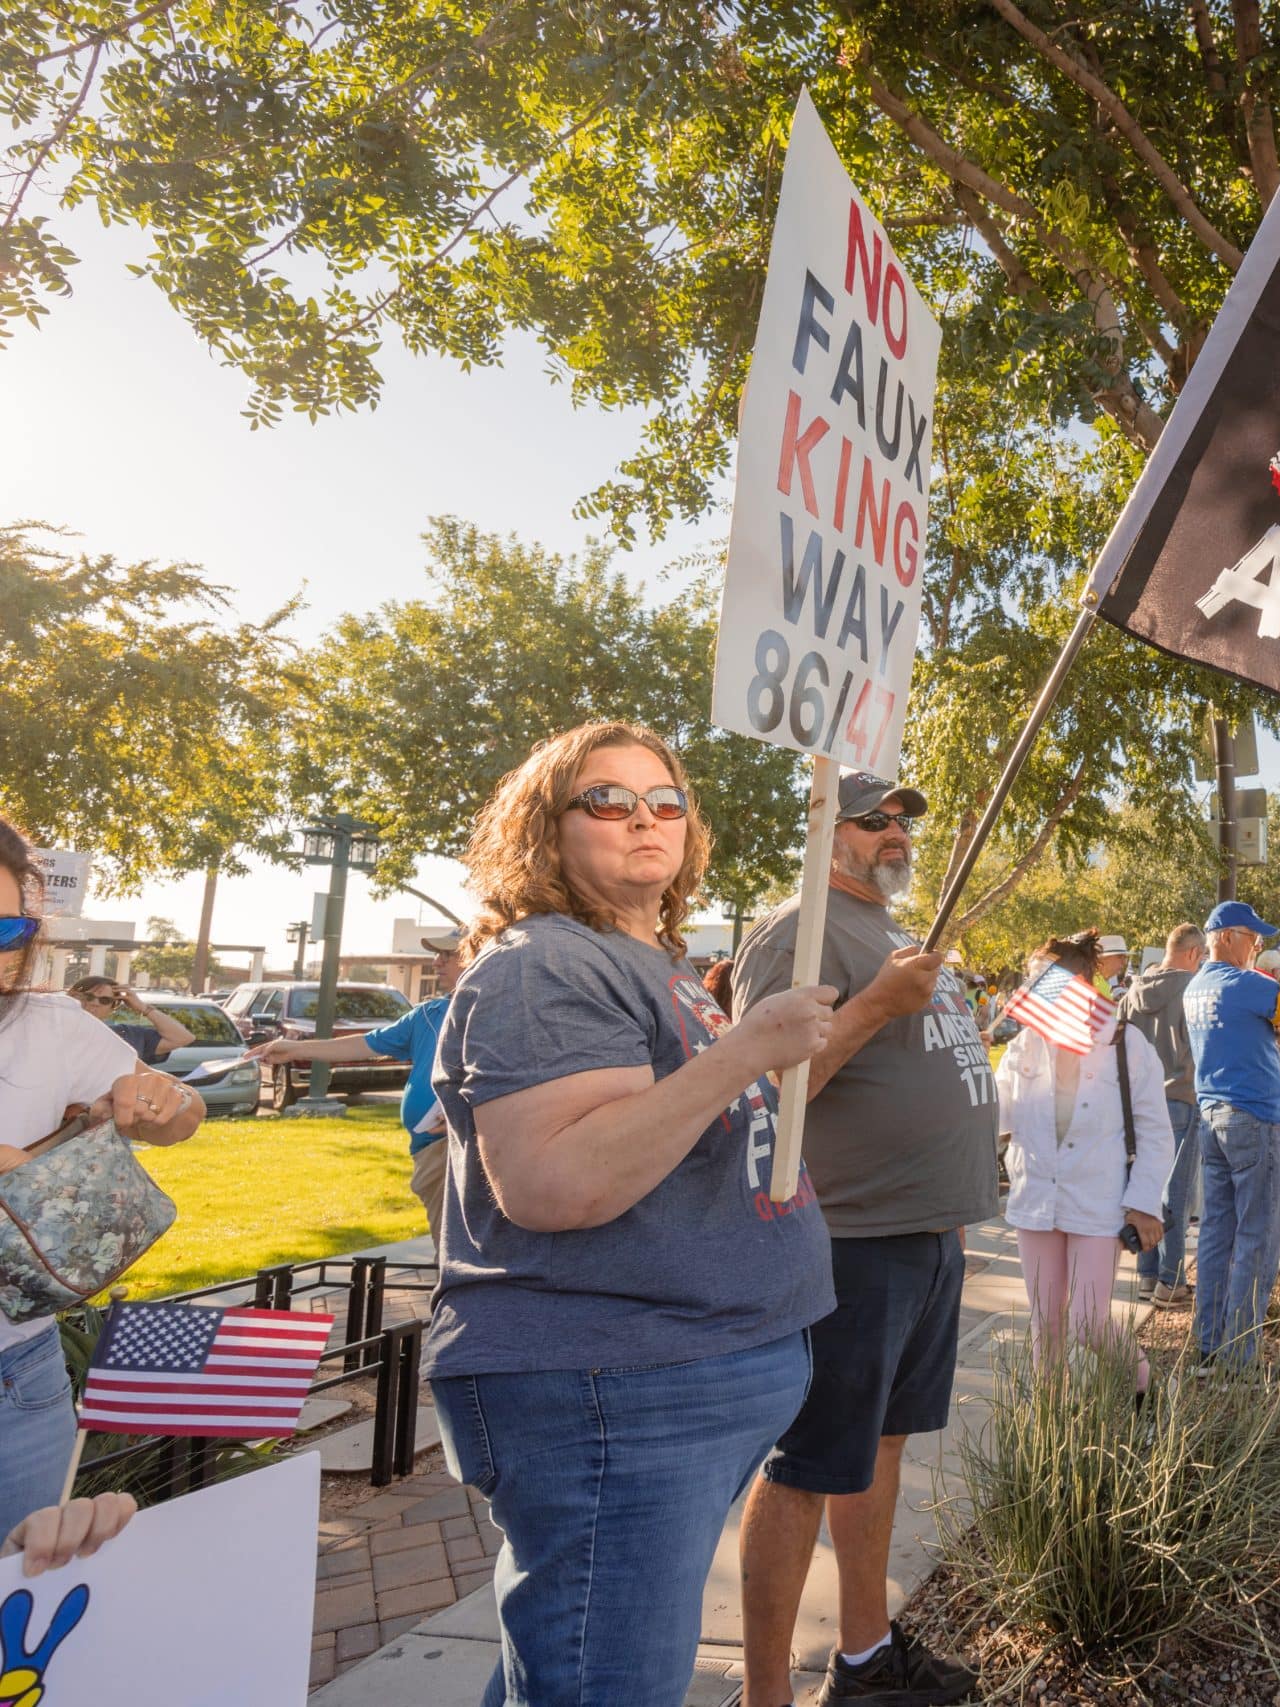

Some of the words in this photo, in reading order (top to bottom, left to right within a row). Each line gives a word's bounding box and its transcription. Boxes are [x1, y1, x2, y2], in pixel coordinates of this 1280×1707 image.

[845, 198, 908, 360] NO
[791, 268, 928, 494] FAUX
[776, 389, 919, 588] KING
[779, 511, 904, 676] WAY
[747, 628, 896, 770] 86/47
[47, 874, 78, 889] TERS
[953, 1045, 990, 1068] SIN
[960, 1065, 998, 1107] 177
